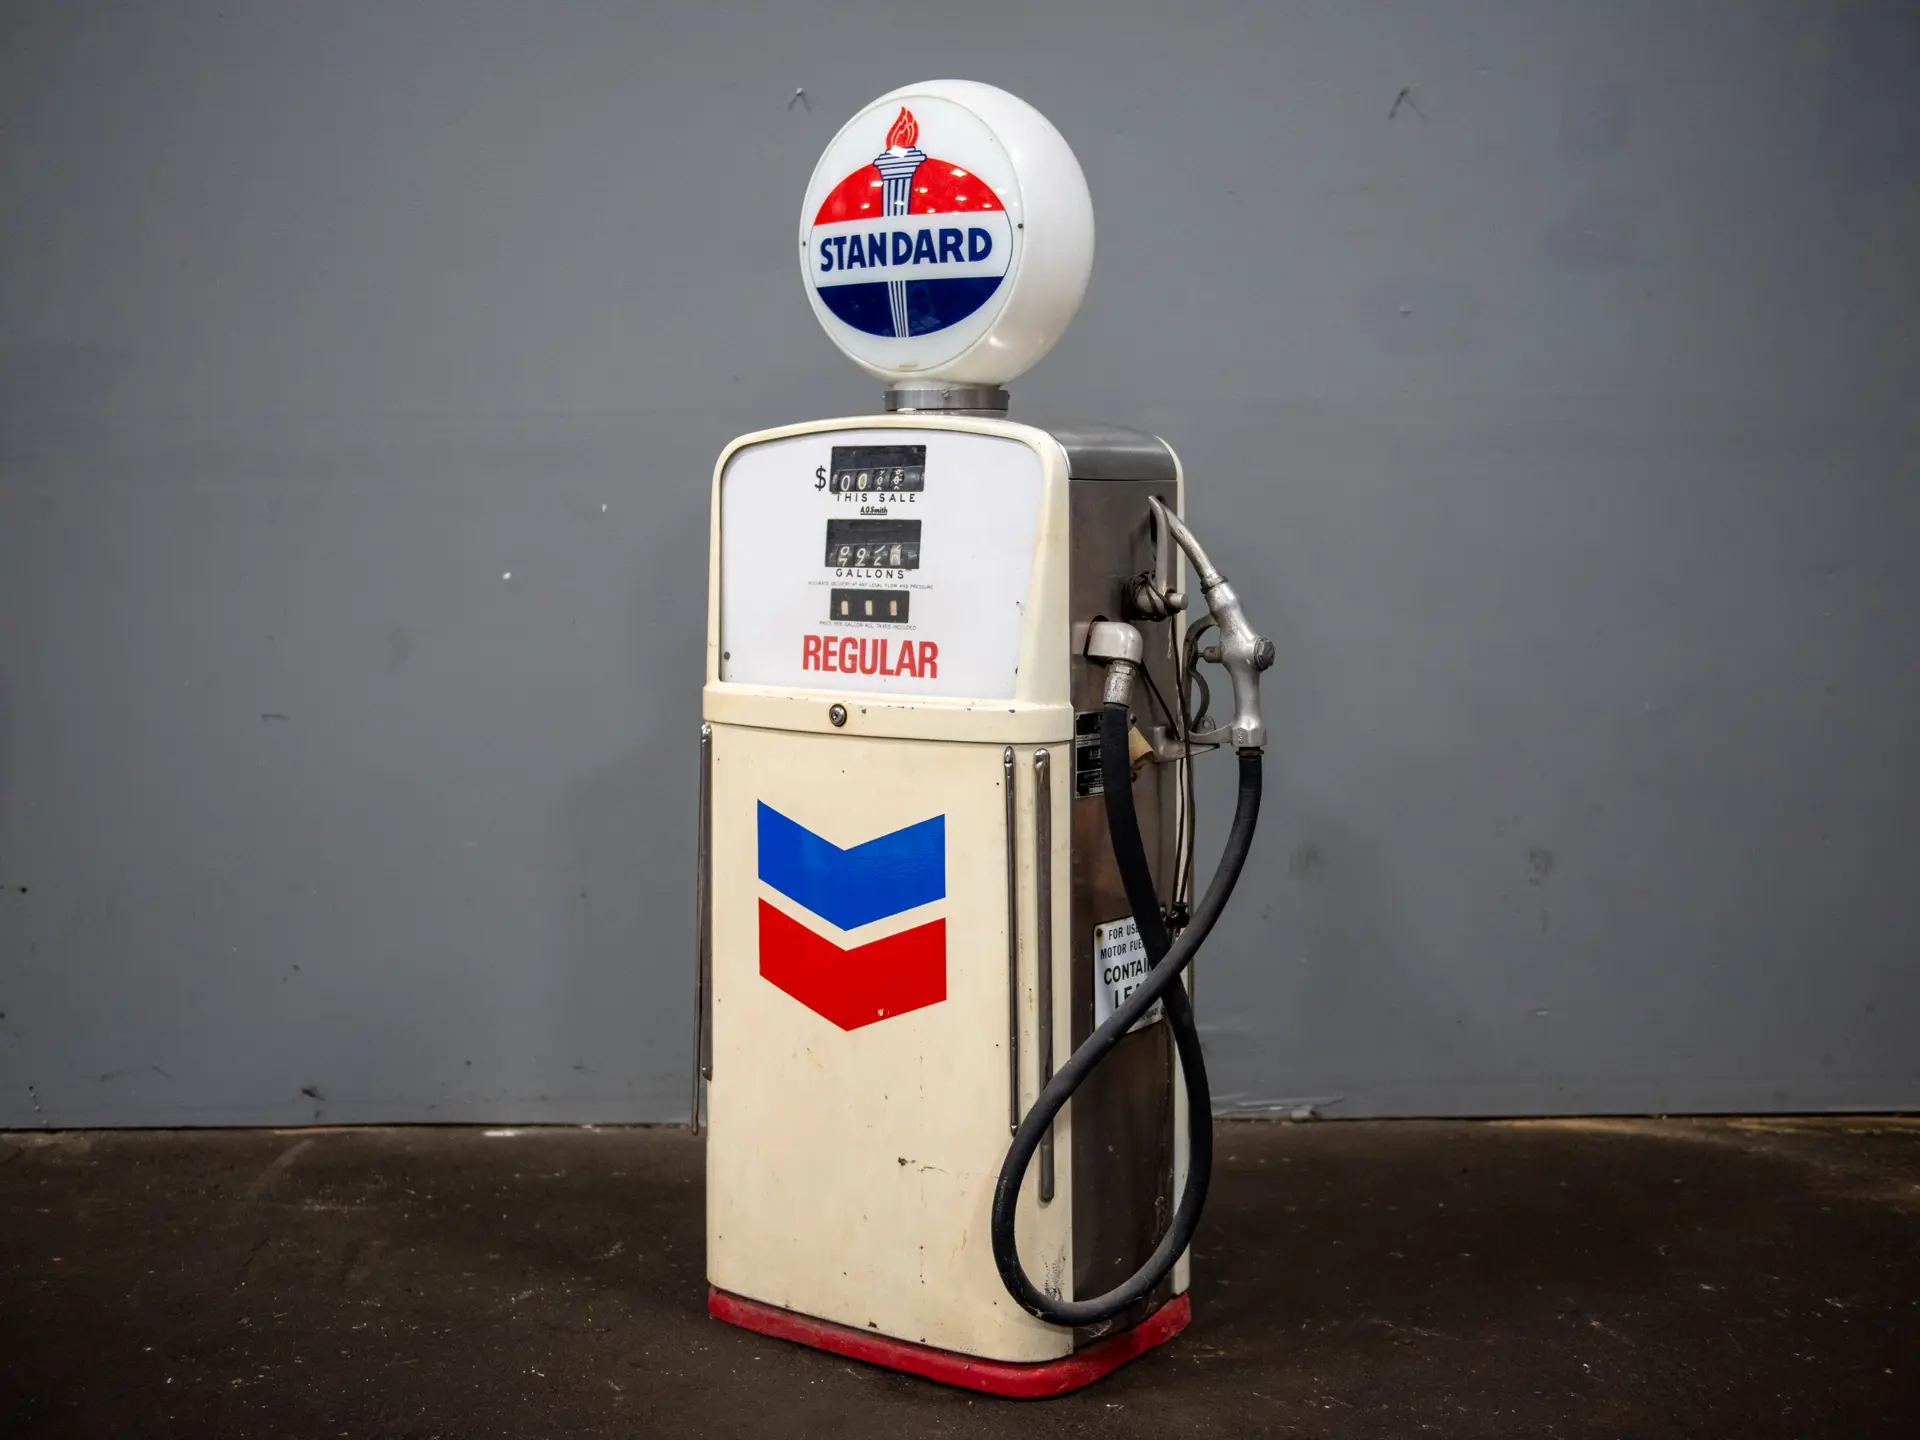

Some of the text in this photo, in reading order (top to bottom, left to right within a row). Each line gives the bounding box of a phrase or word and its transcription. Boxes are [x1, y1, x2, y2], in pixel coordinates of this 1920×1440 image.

[820, 227, 992, 272] STANDARD
[814, 465, 827, 491] $
[837, 493, 916, 503] THIS SALE
[835, 568, 904, 579] GALLONS
[802, 635, 938, 679] REGULAR
[1108, 927, 1123, 940] FOR
[1100, 943, 1127, 960] MOTOR
